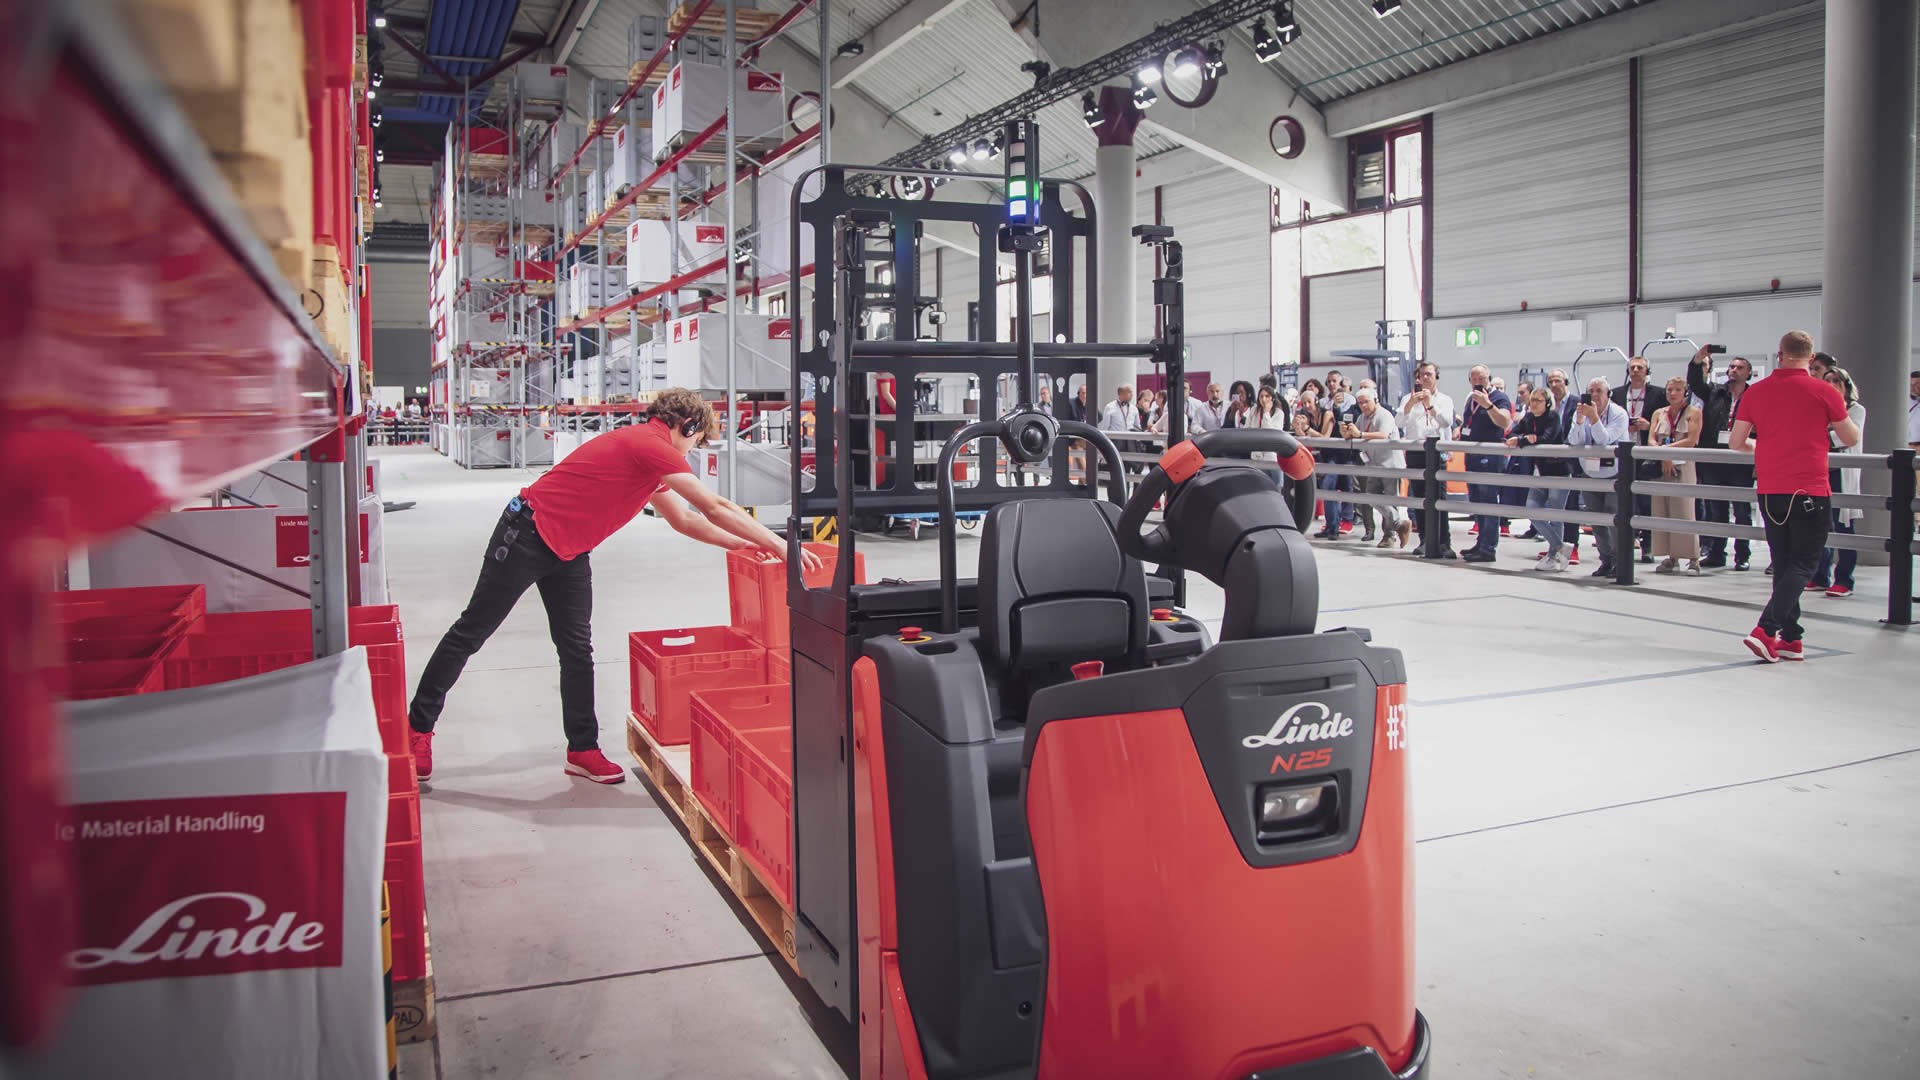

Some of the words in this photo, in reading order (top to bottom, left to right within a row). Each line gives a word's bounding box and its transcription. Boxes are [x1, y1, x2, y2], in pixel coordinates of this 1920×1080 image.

[1242, 701, 1354, 749] Linde
[1269, 747, 1334, 775] N25
[81, 814, 170, 839] Material
[175, 811, 265, 834] Handling
[62, 892, 325, 969] Linde
